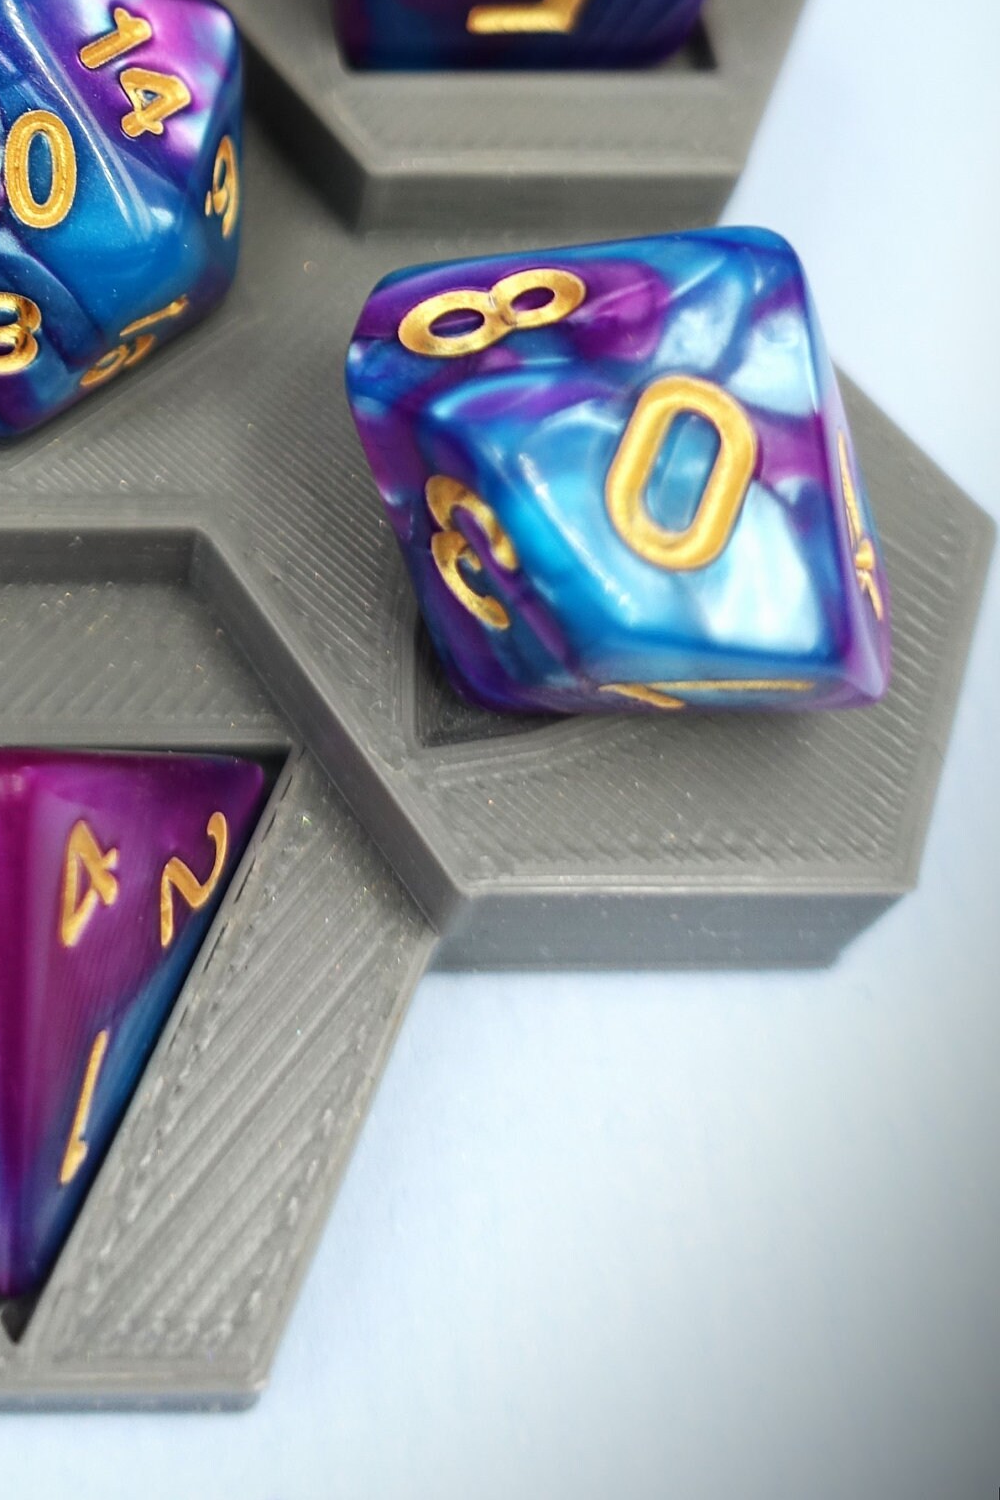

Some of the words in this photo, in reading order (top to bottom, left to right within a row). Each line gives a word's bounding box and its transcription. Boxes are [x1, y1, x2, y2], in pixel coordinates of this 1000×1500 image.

[79, 7, 192, 140] 14
[397, 268, 588, 359] 8
[604, 374, 759, 572] 0
[424, 474, 518, 631] 3
[59, 819, 121, 948] 4
[158, 811, 229, 948] 2
